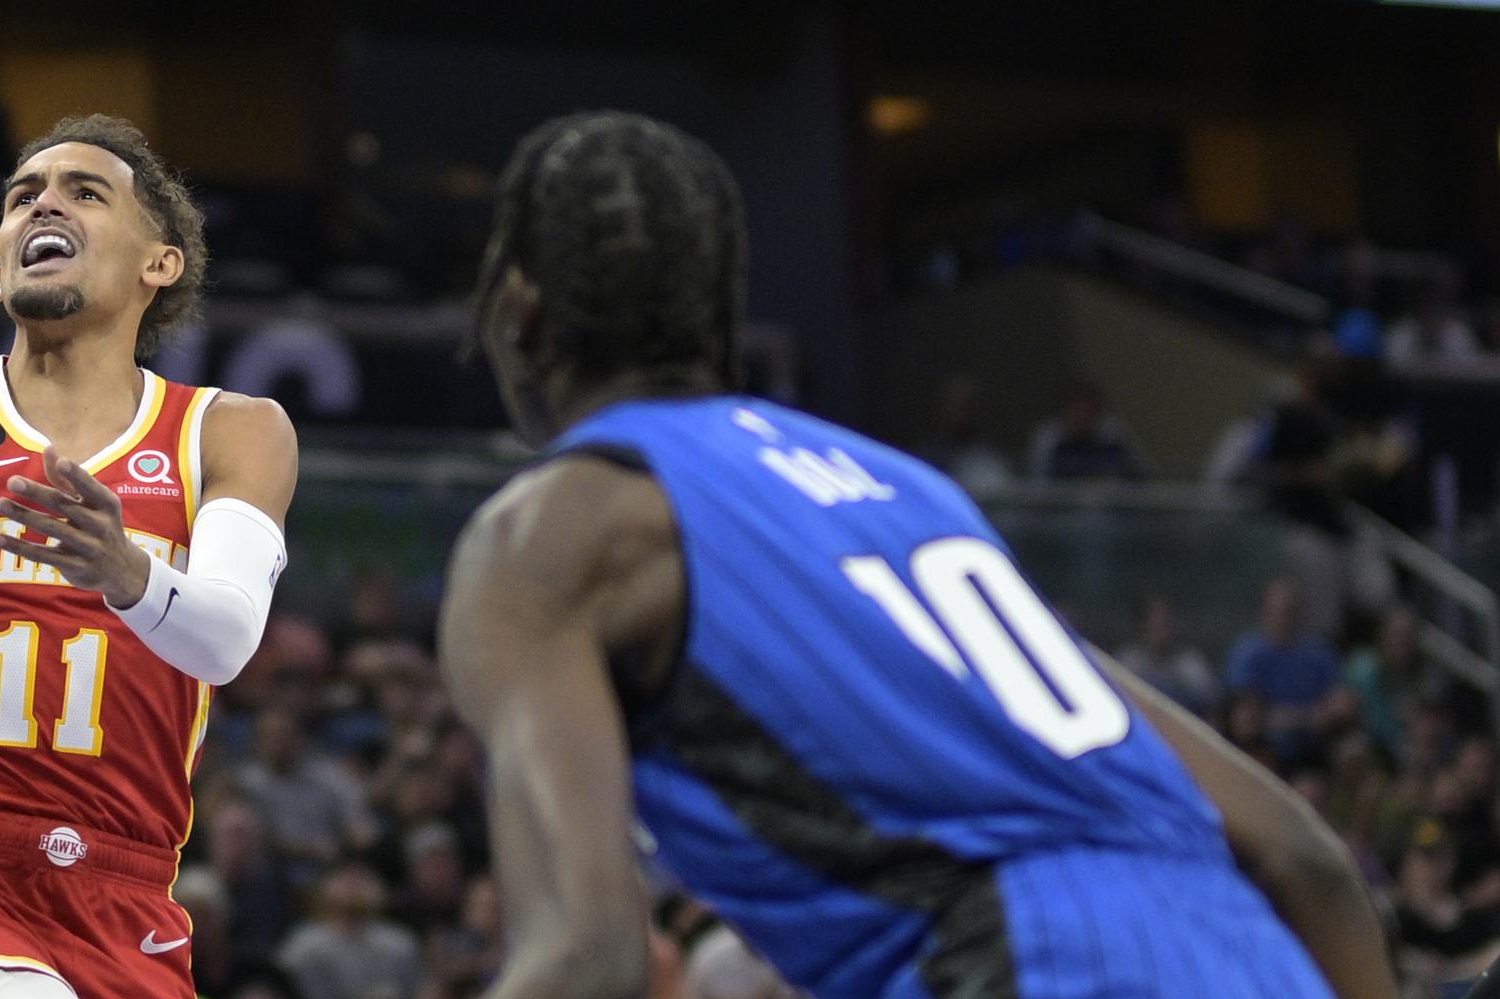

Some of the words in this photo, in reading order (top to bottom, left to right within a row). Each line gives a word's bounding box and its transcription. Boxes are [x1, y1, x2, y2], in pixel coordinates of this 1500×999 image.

[116, 484, 180, 497] sharecare
[839, 536, 1130, 759] 10
[39, 834, 88, 860] HAWKS
